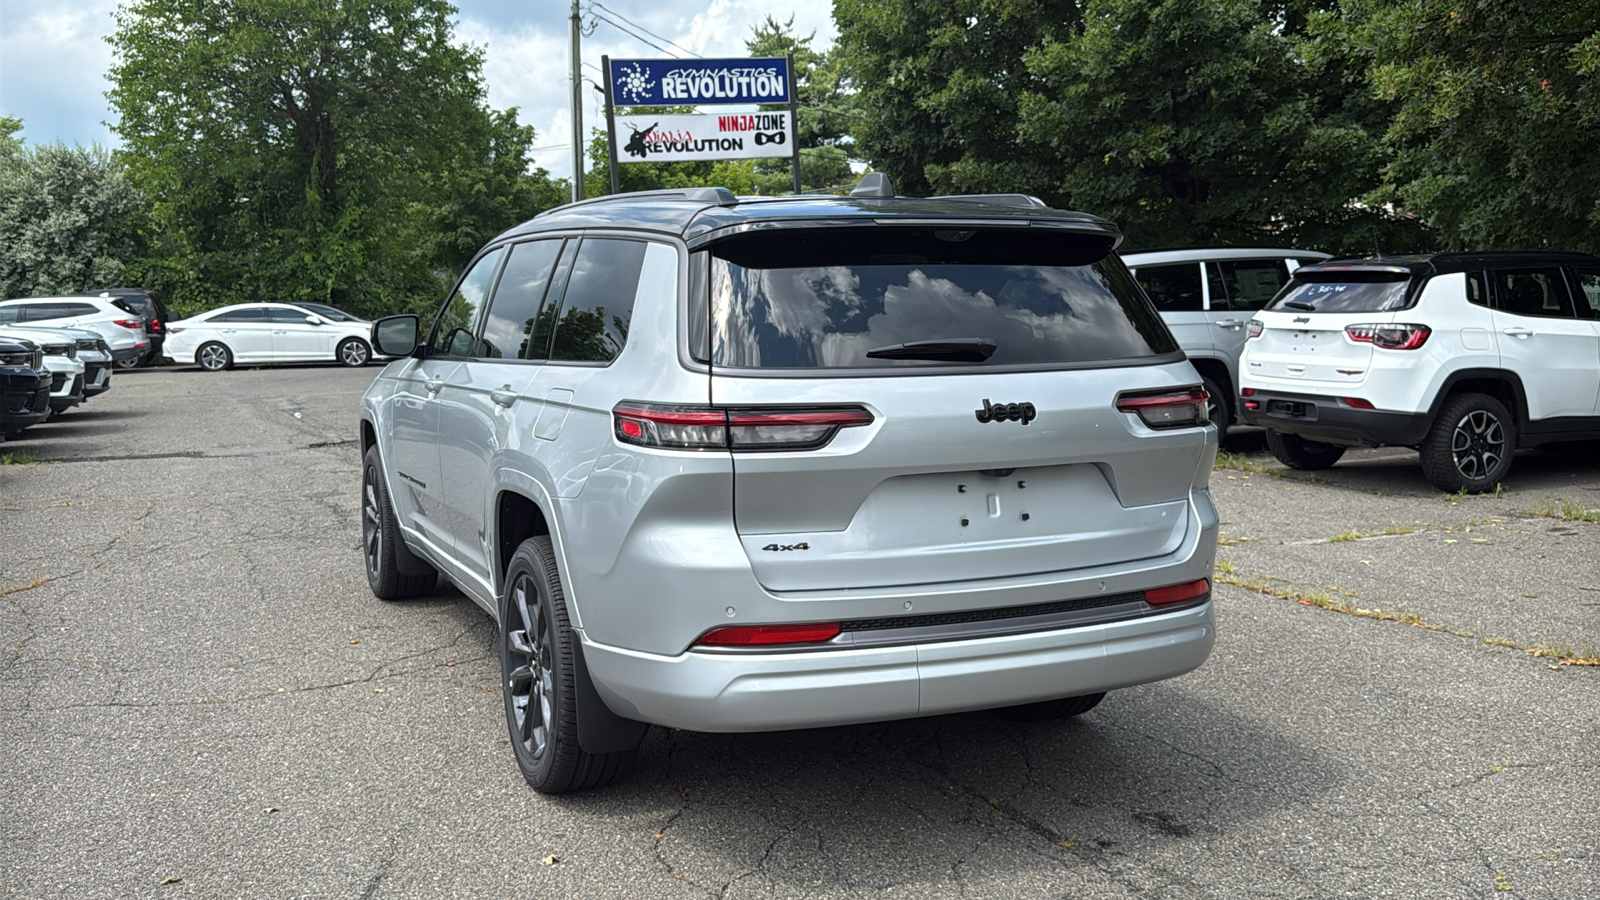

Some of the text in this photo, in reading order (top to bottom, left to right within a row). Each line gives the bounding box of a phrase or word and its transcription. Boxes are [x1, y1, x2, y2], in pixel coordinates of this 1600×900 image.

[667, 67, 777, 79] GYMNASTICS
[661, 76, 784, 98] REVOLUTION
[718, 114, 786, 132] NINJAZONE
[645, 138, 743, 153] REVOLUTION
[975, 399, 1036, 425] Jeep
[761, 542, 810, 551] 4x4
